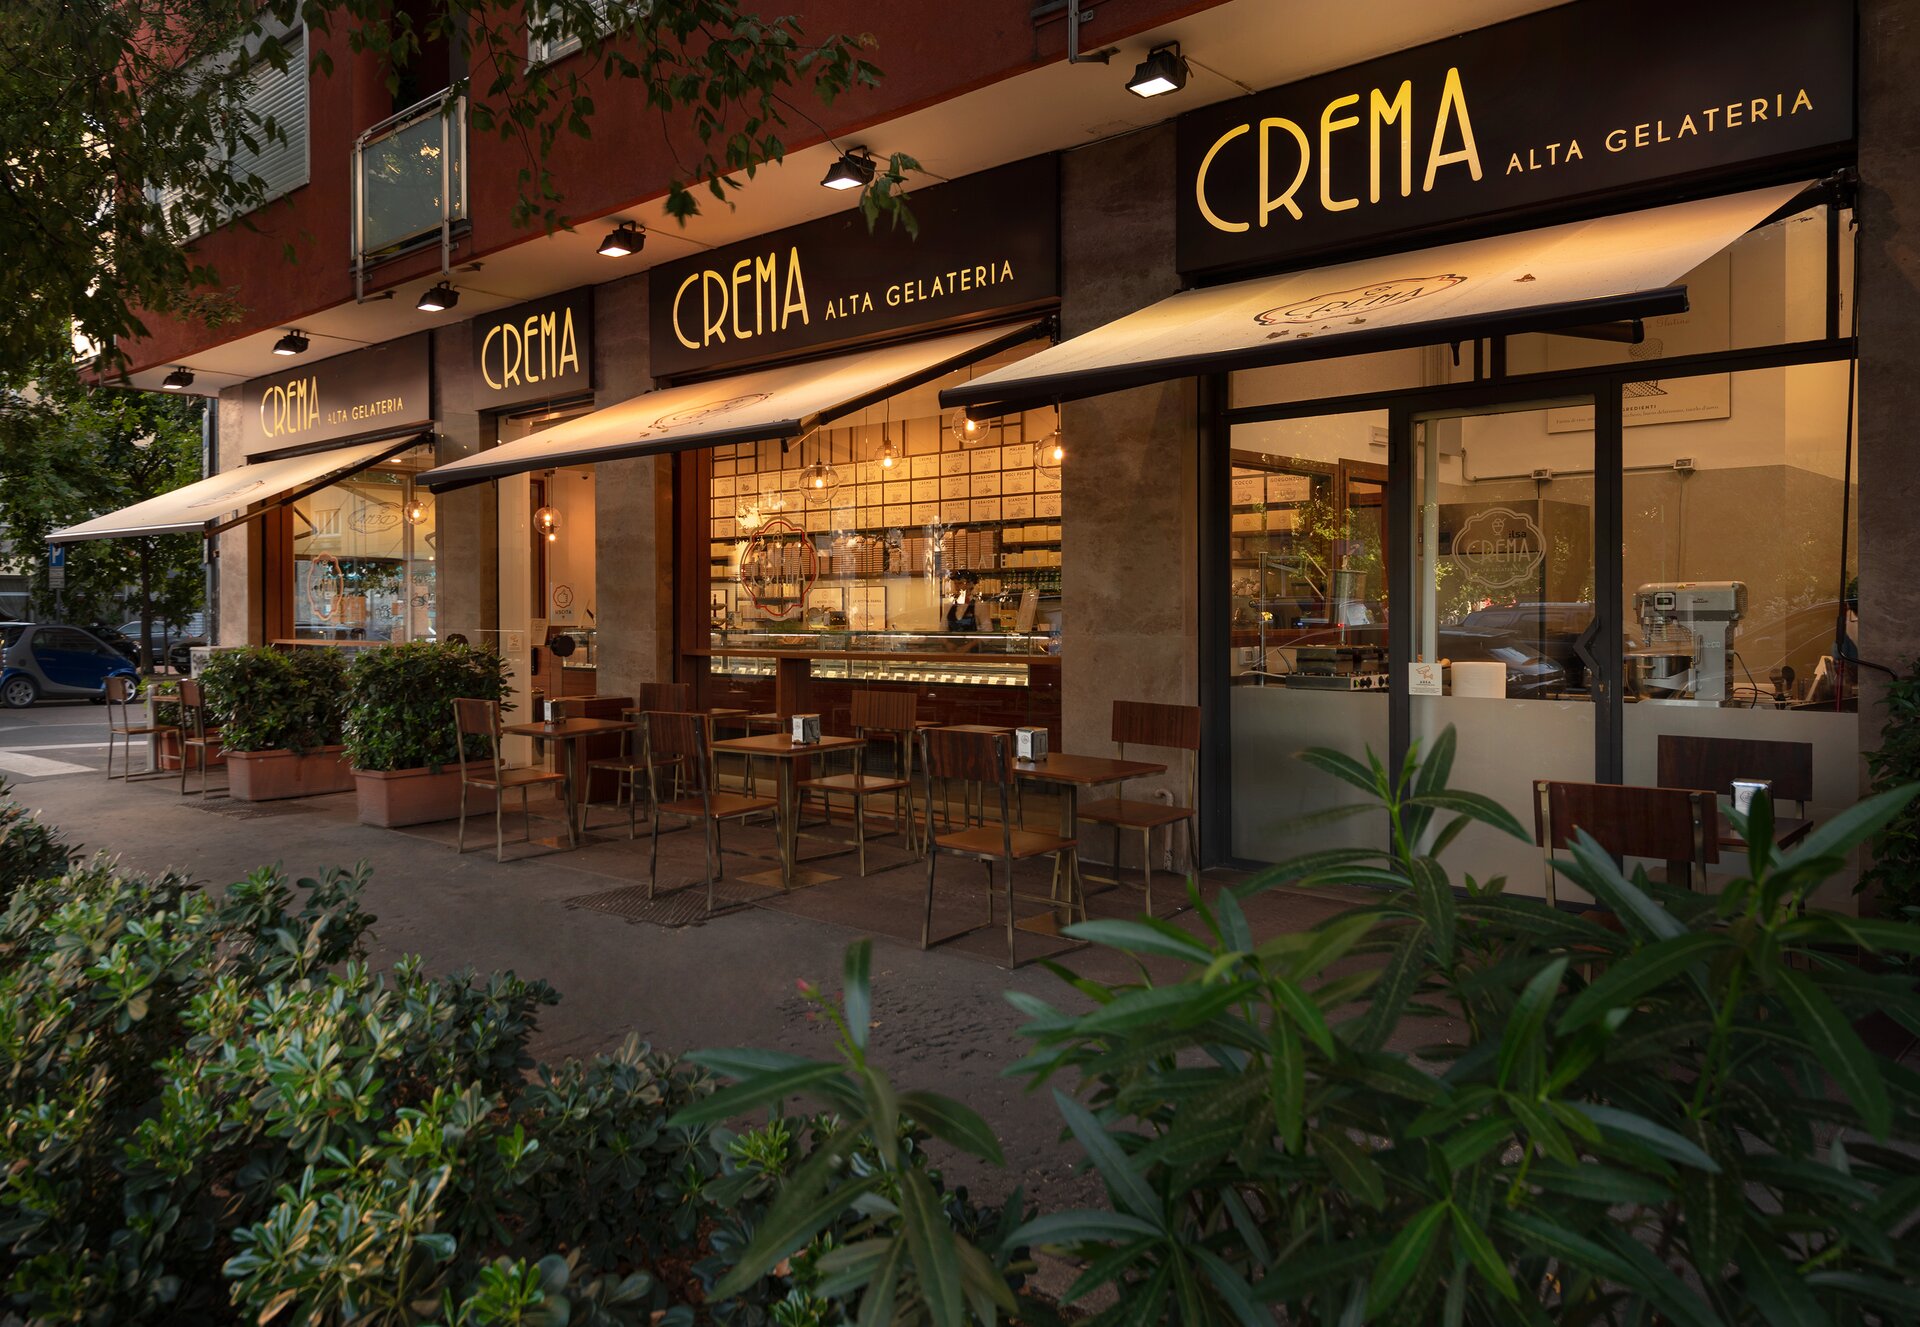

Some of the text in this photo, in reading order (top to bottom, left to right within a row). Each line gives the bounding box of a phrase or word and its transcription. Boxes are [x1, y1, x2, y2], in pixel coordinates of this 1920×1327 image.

[1196, 66, 1813, 233] CREMA ALTA GELATERIA
[673, 246, 1014, 350] CREMA ALTA GELATERIA
[481, 307, 579, 390] CREMA
[260, 376, 404, 438] CREMA ALTA GELATERIA
[1467, 538, 1531, 563] CREMA
